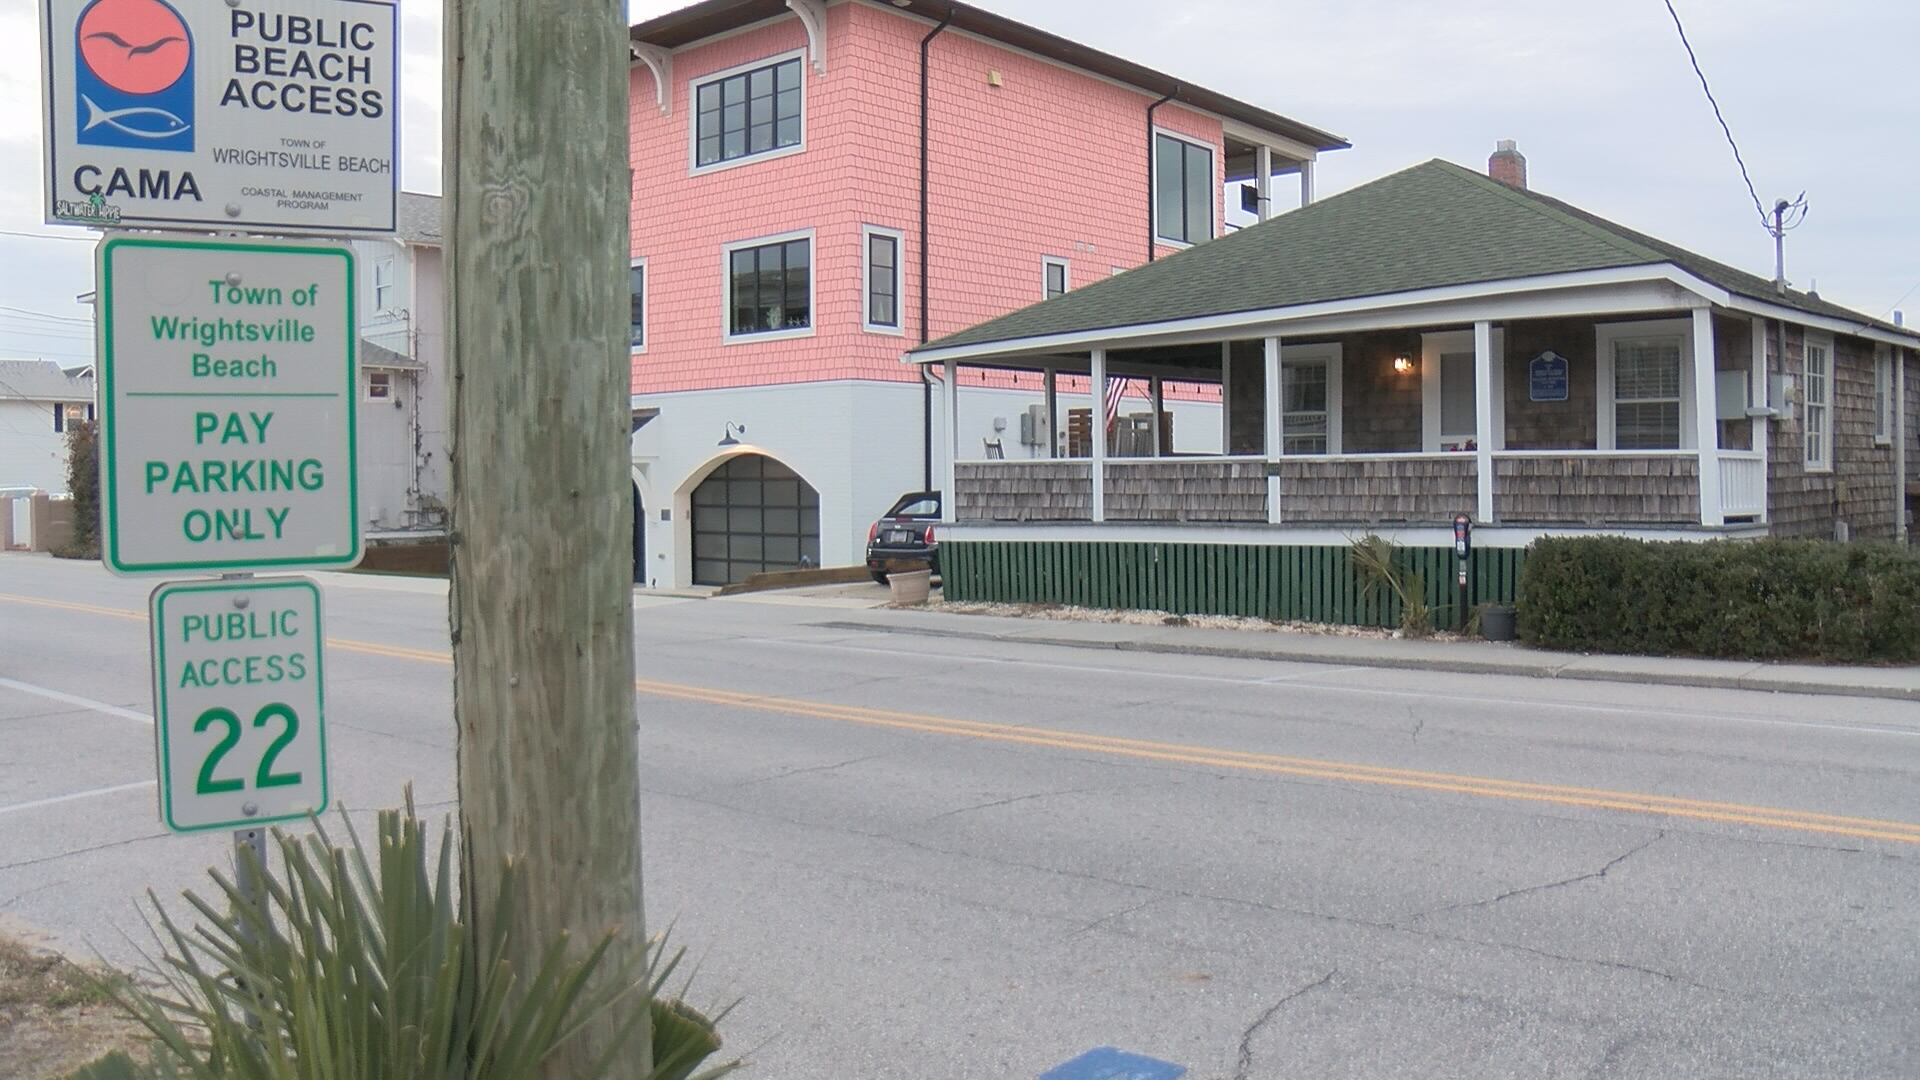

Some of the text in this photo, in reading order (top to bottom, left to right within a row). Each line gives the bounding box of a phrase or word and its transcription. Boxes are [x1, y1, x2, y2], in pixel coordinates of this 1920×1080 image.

[230, 9, 376, 51] PUBLIC
[235, 44, 372, 84] BEACH
[220, 78, 384, 119] ACCESS
[280, 138, 326, 149] TOWN OF
[213, 148, 391, 174] WRIGHTSVILLE BEACH
[74, 164, 203, 201] CAMA
[241, 187, 363, 202] COASTAL MANAGEMENT
[277, 200, 329, 210] PROGRAM
[209, 280, 319, 306] Town of
[151, 315, 315, 346] Wrightsville
[192, 353, 277, 377] Beach
[196, 412, 274, 444] PAY
[145, 459, 324, 494] PARKING
[183, 507, 290, 541] ONLY
[183, 609, 299, 642] PUBLIC
[180, 653, 306, 688] ACCESS
[194, 702, 302, 795] 22
